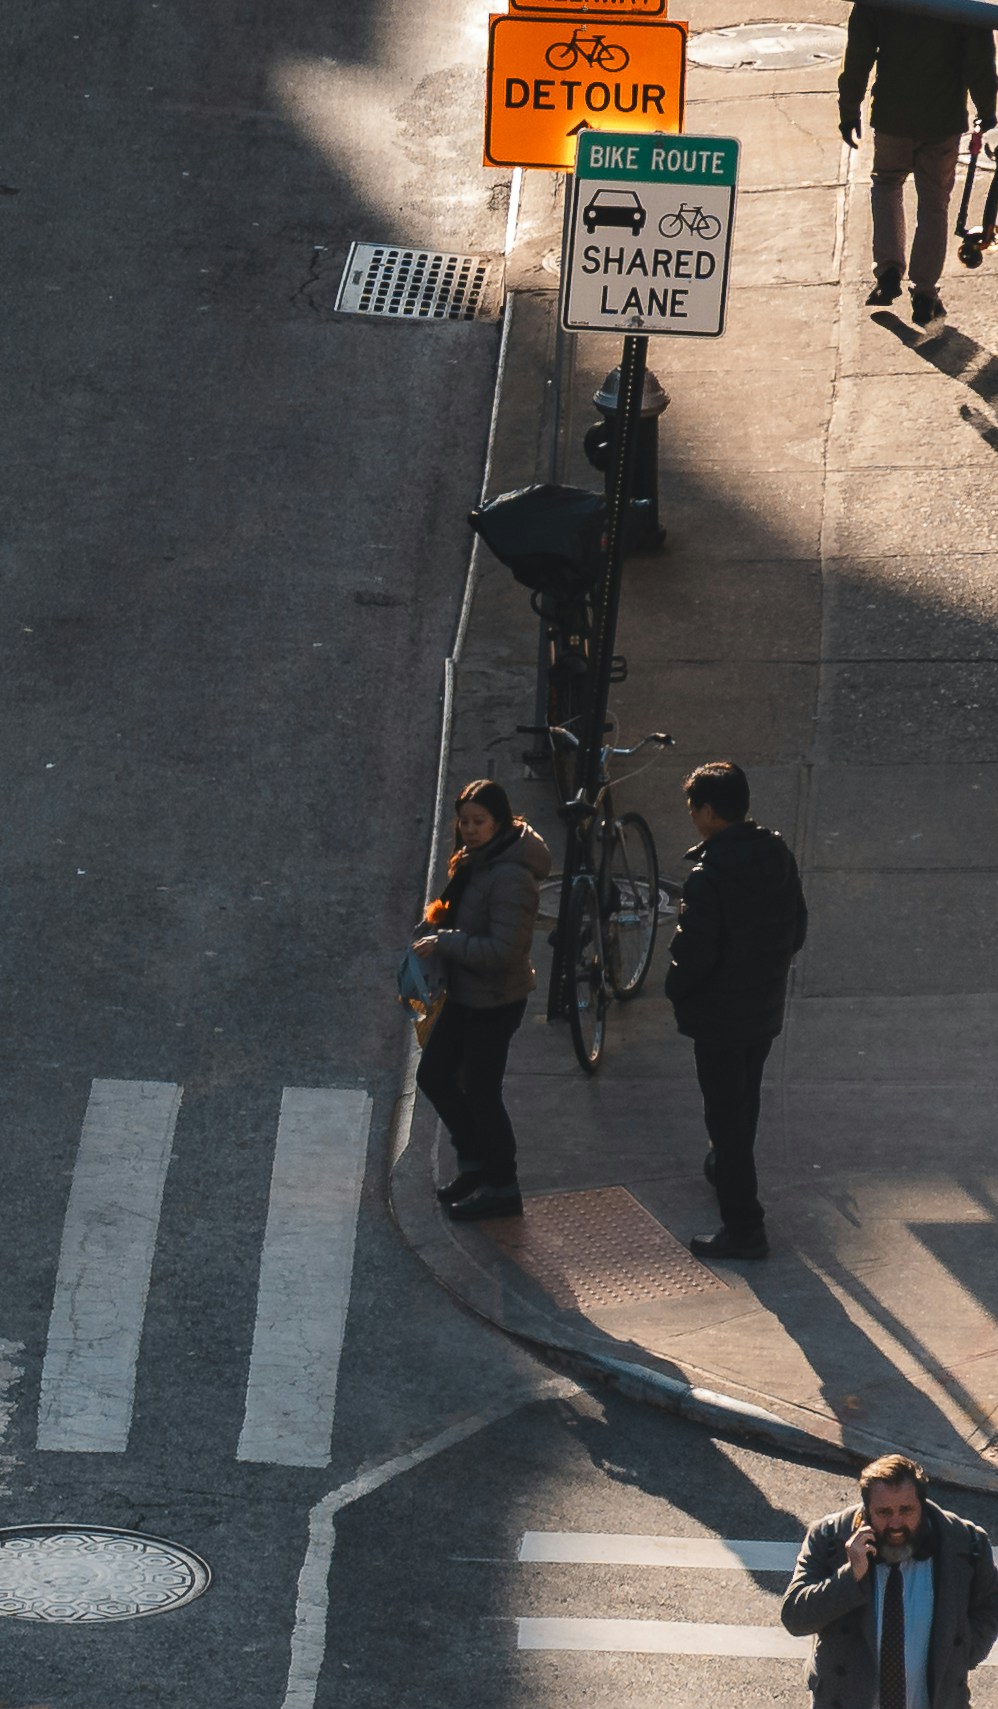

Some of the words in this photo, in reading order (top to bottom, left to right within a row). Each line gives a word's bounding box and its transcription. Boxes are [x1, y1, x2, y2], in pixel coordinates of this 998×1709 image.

[504, 78, 666, 115] DETOUR
[589, 145, 640, 170] BIKE
[651, 149, 725, 174] ROUTE
[581, 245, 716, 280] SHARED
[600, 285, 689, 318] LANE
